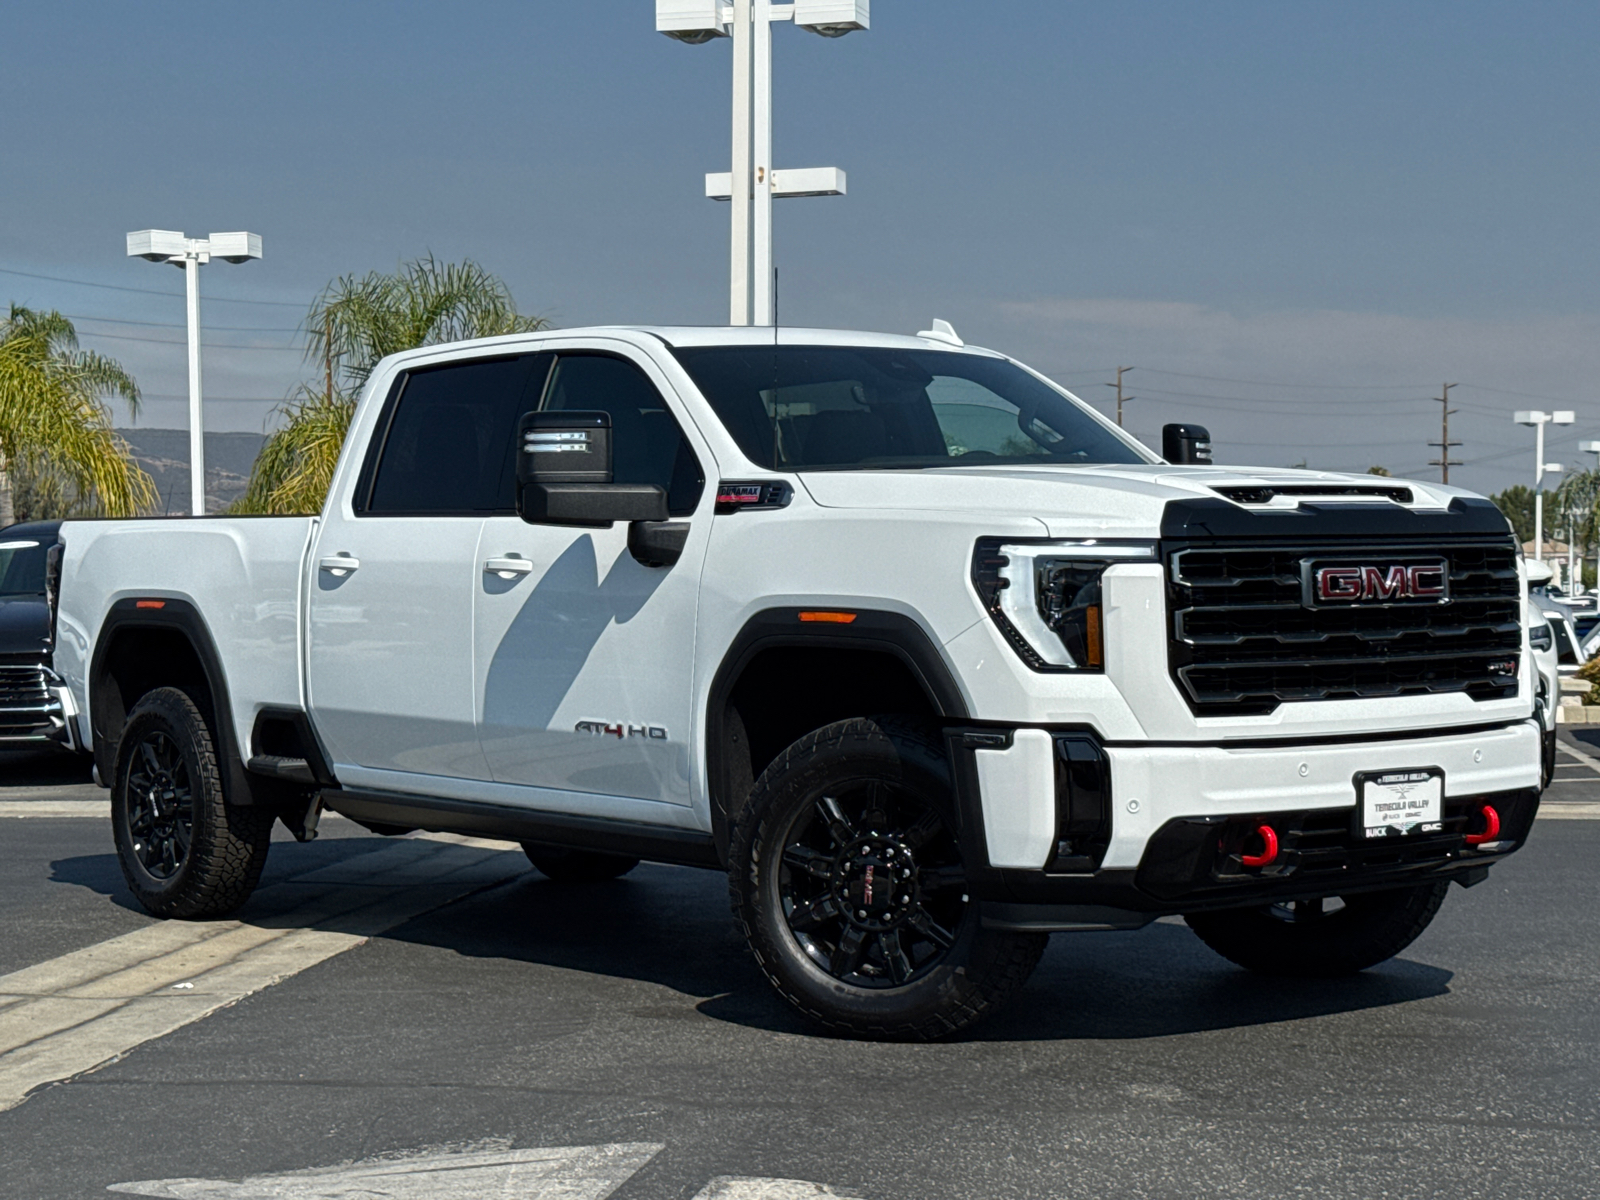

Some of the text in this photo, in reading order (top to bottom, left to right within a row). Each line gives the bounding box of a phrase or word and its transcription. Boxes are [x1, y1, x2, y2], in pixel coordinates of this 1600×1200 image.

[721, 486, 759, 496] DURAMAX
[1317, 565, 1444, 600] GMC
[628, 724, 668, 740] HD
[1365, 828, 1388, 838] BUICK
